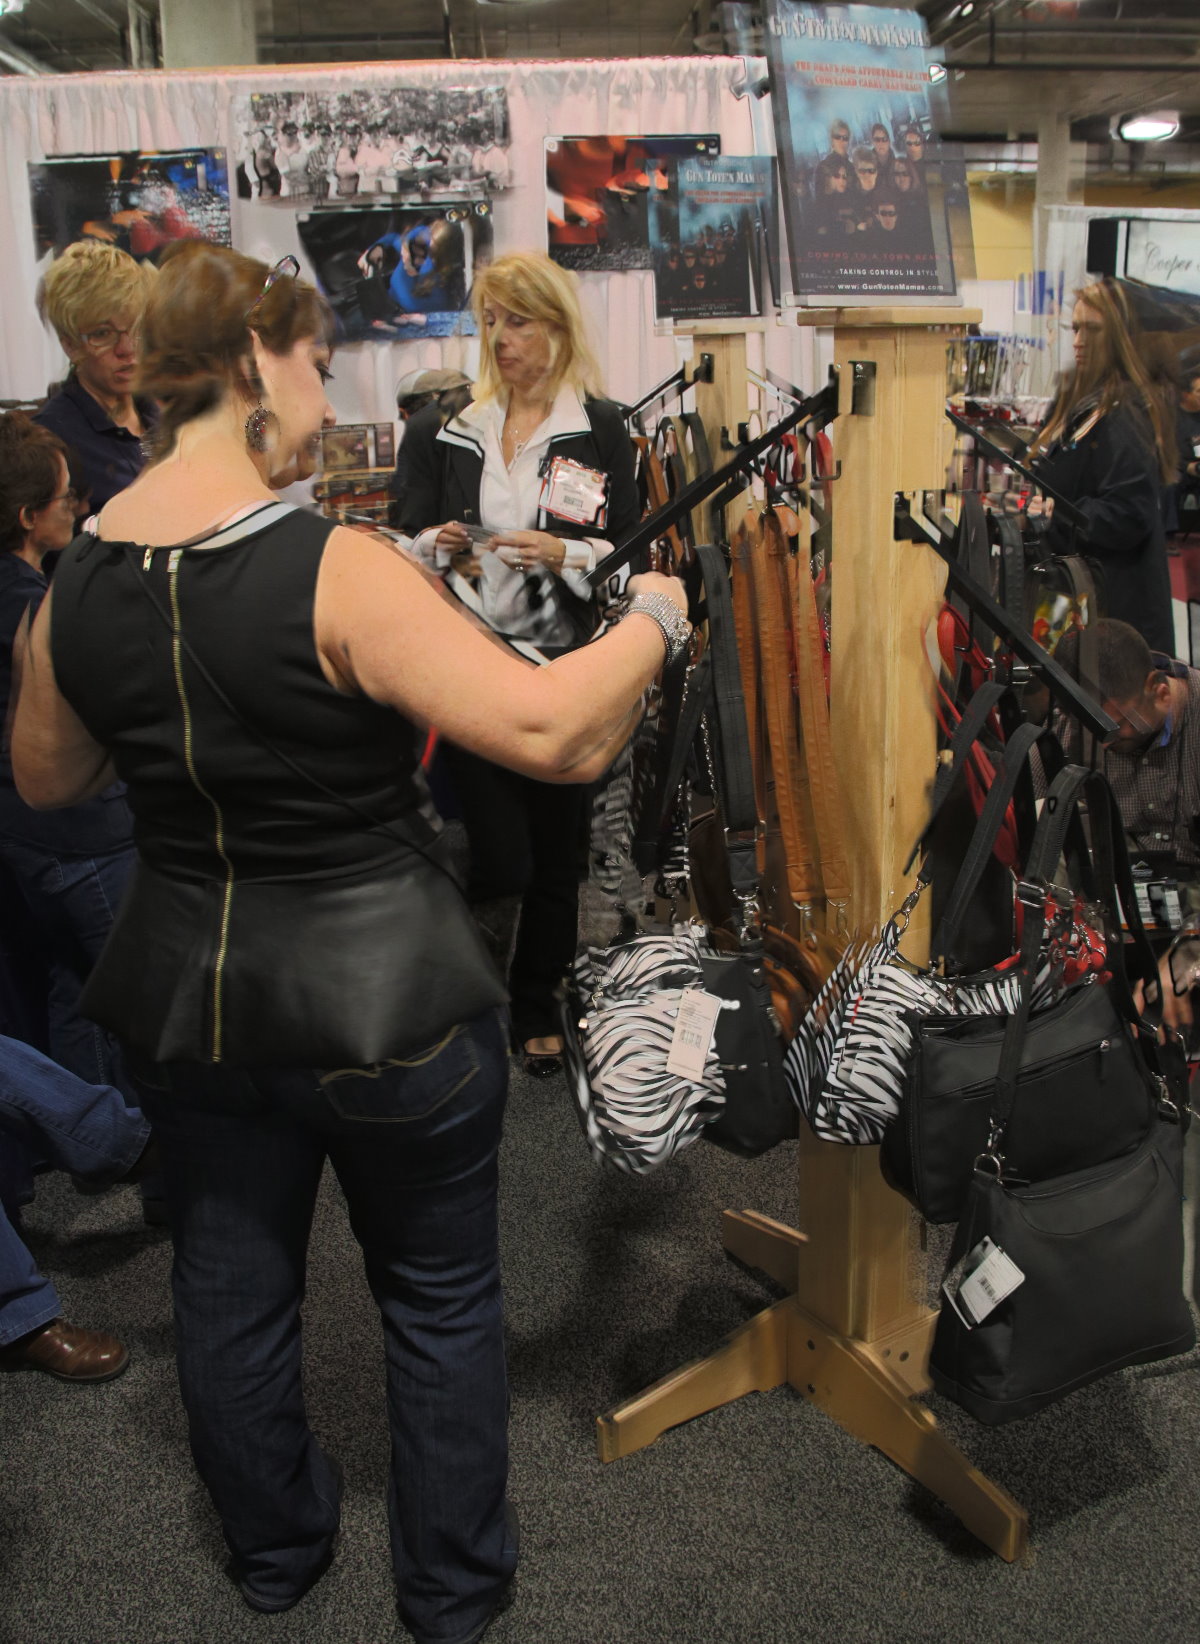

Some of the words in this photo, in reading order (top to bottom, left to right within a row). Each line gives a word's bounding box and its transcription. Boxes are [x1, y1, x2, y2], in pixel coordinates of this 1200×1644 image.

[839, 268, 867, 276] TAKING
[869, 269, 904, 277] CONTROL
[906, 269, 915, 277] IN
